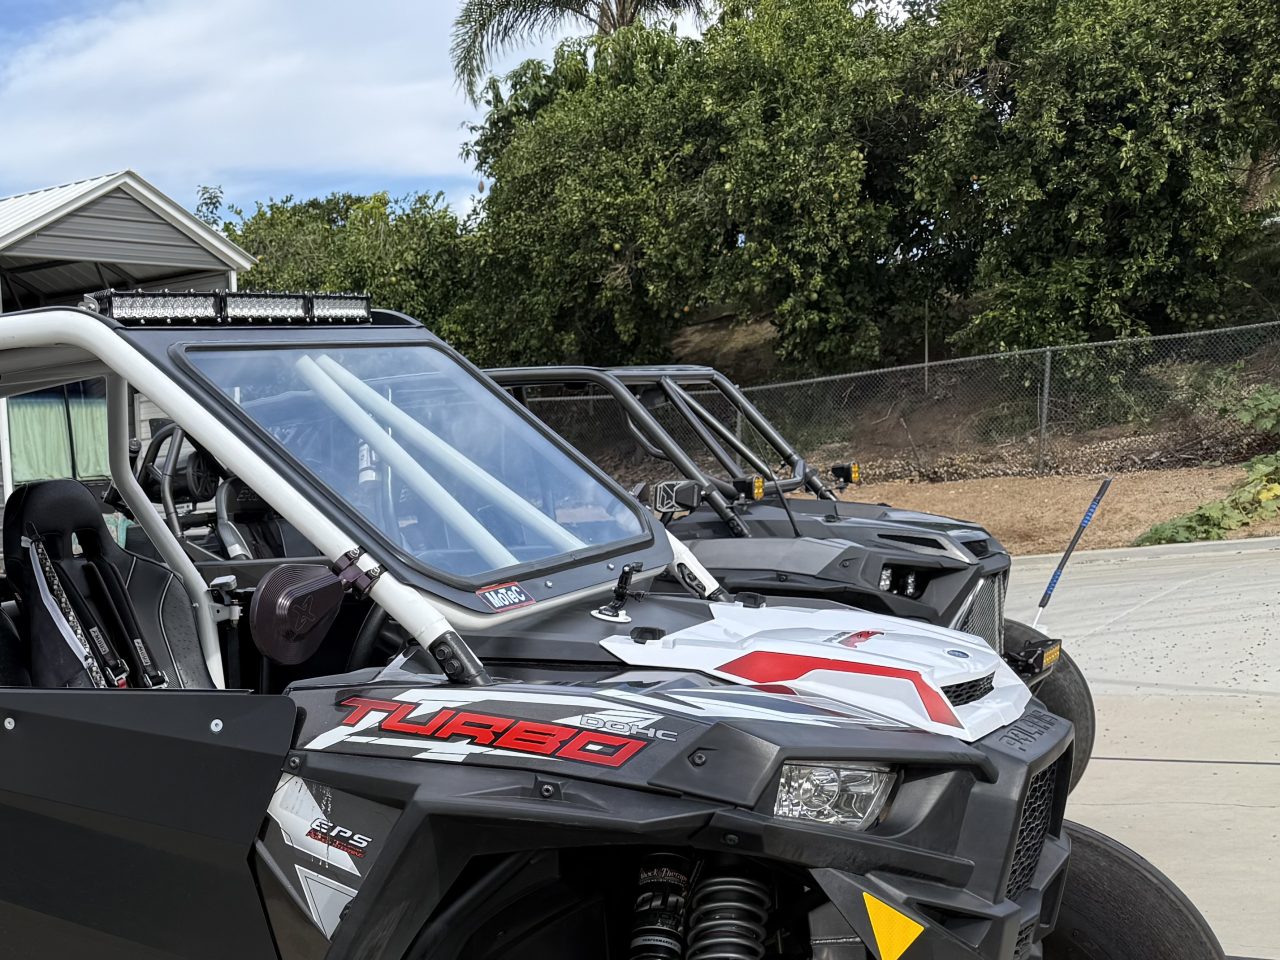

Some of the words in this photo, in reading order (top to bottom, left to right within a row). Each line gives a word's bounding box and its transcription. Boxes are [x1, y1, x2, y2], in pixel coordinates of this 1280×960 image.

[485, 586, 525, 608] MoTeC
[340, 697, 649, 767] TURBO
[579, 714, 679, 742] DOHC
[310, 818, 373, 848] EPS
